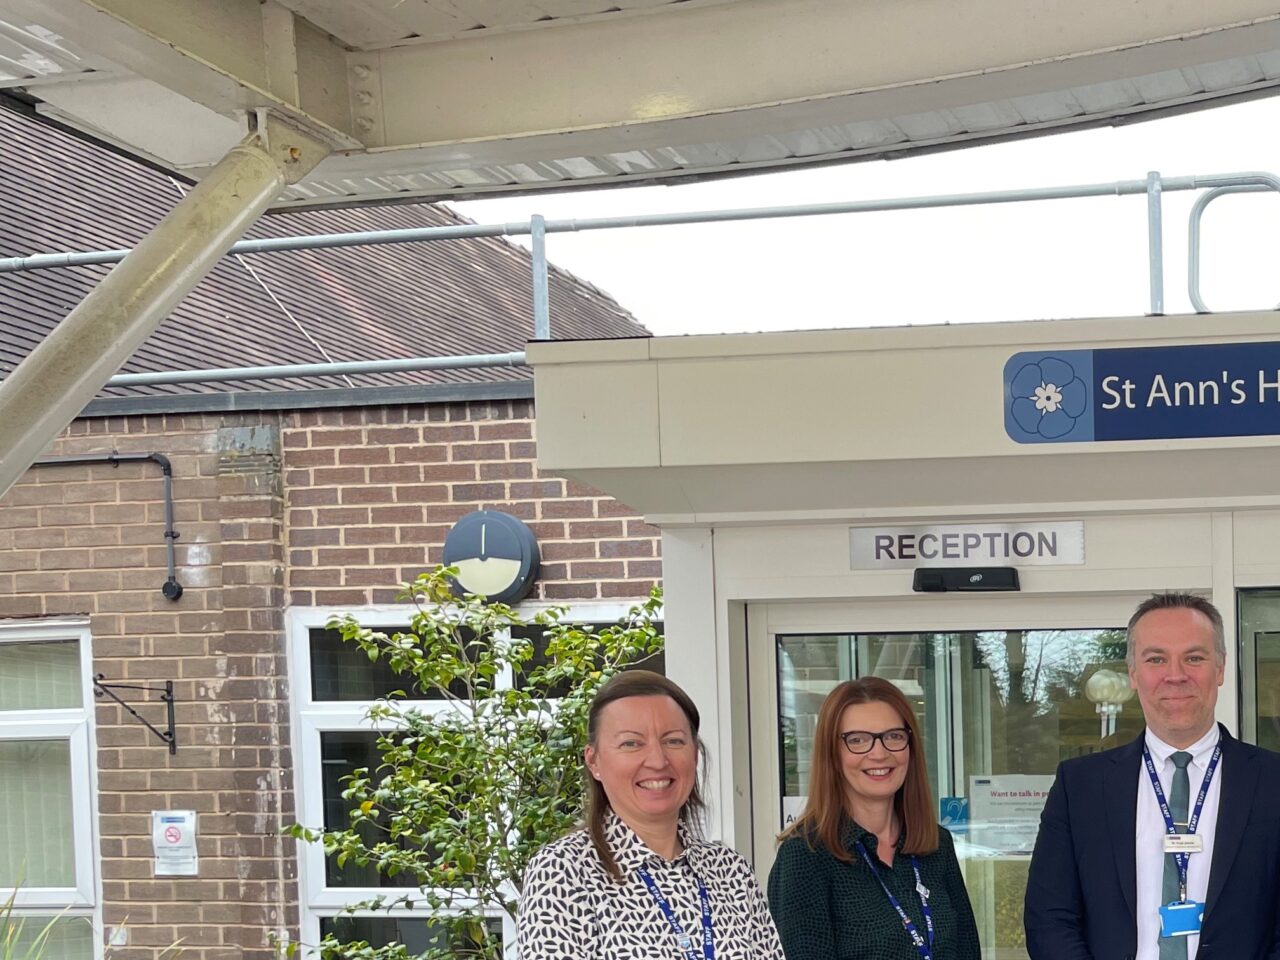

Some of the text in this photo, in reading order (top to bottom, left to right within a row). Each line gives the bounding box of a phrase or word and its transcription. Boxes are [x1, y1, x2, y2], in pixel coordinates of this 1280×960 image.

[1102, 375, 1136, 410] St
[1146, 371, 1246, 408] Ann's
[875, 531, 1057, 560] RECEPTION
[1153, 782, 1163, 796] STAFF
[1161, 803, 1172, 818] STAFF
[1189, 815, 1199, 832] STAFF
[650, 886, 665, 905] STAFF
[668, 915, 682, 934] STAFF
[704, 926, 712, 946] STAFF
